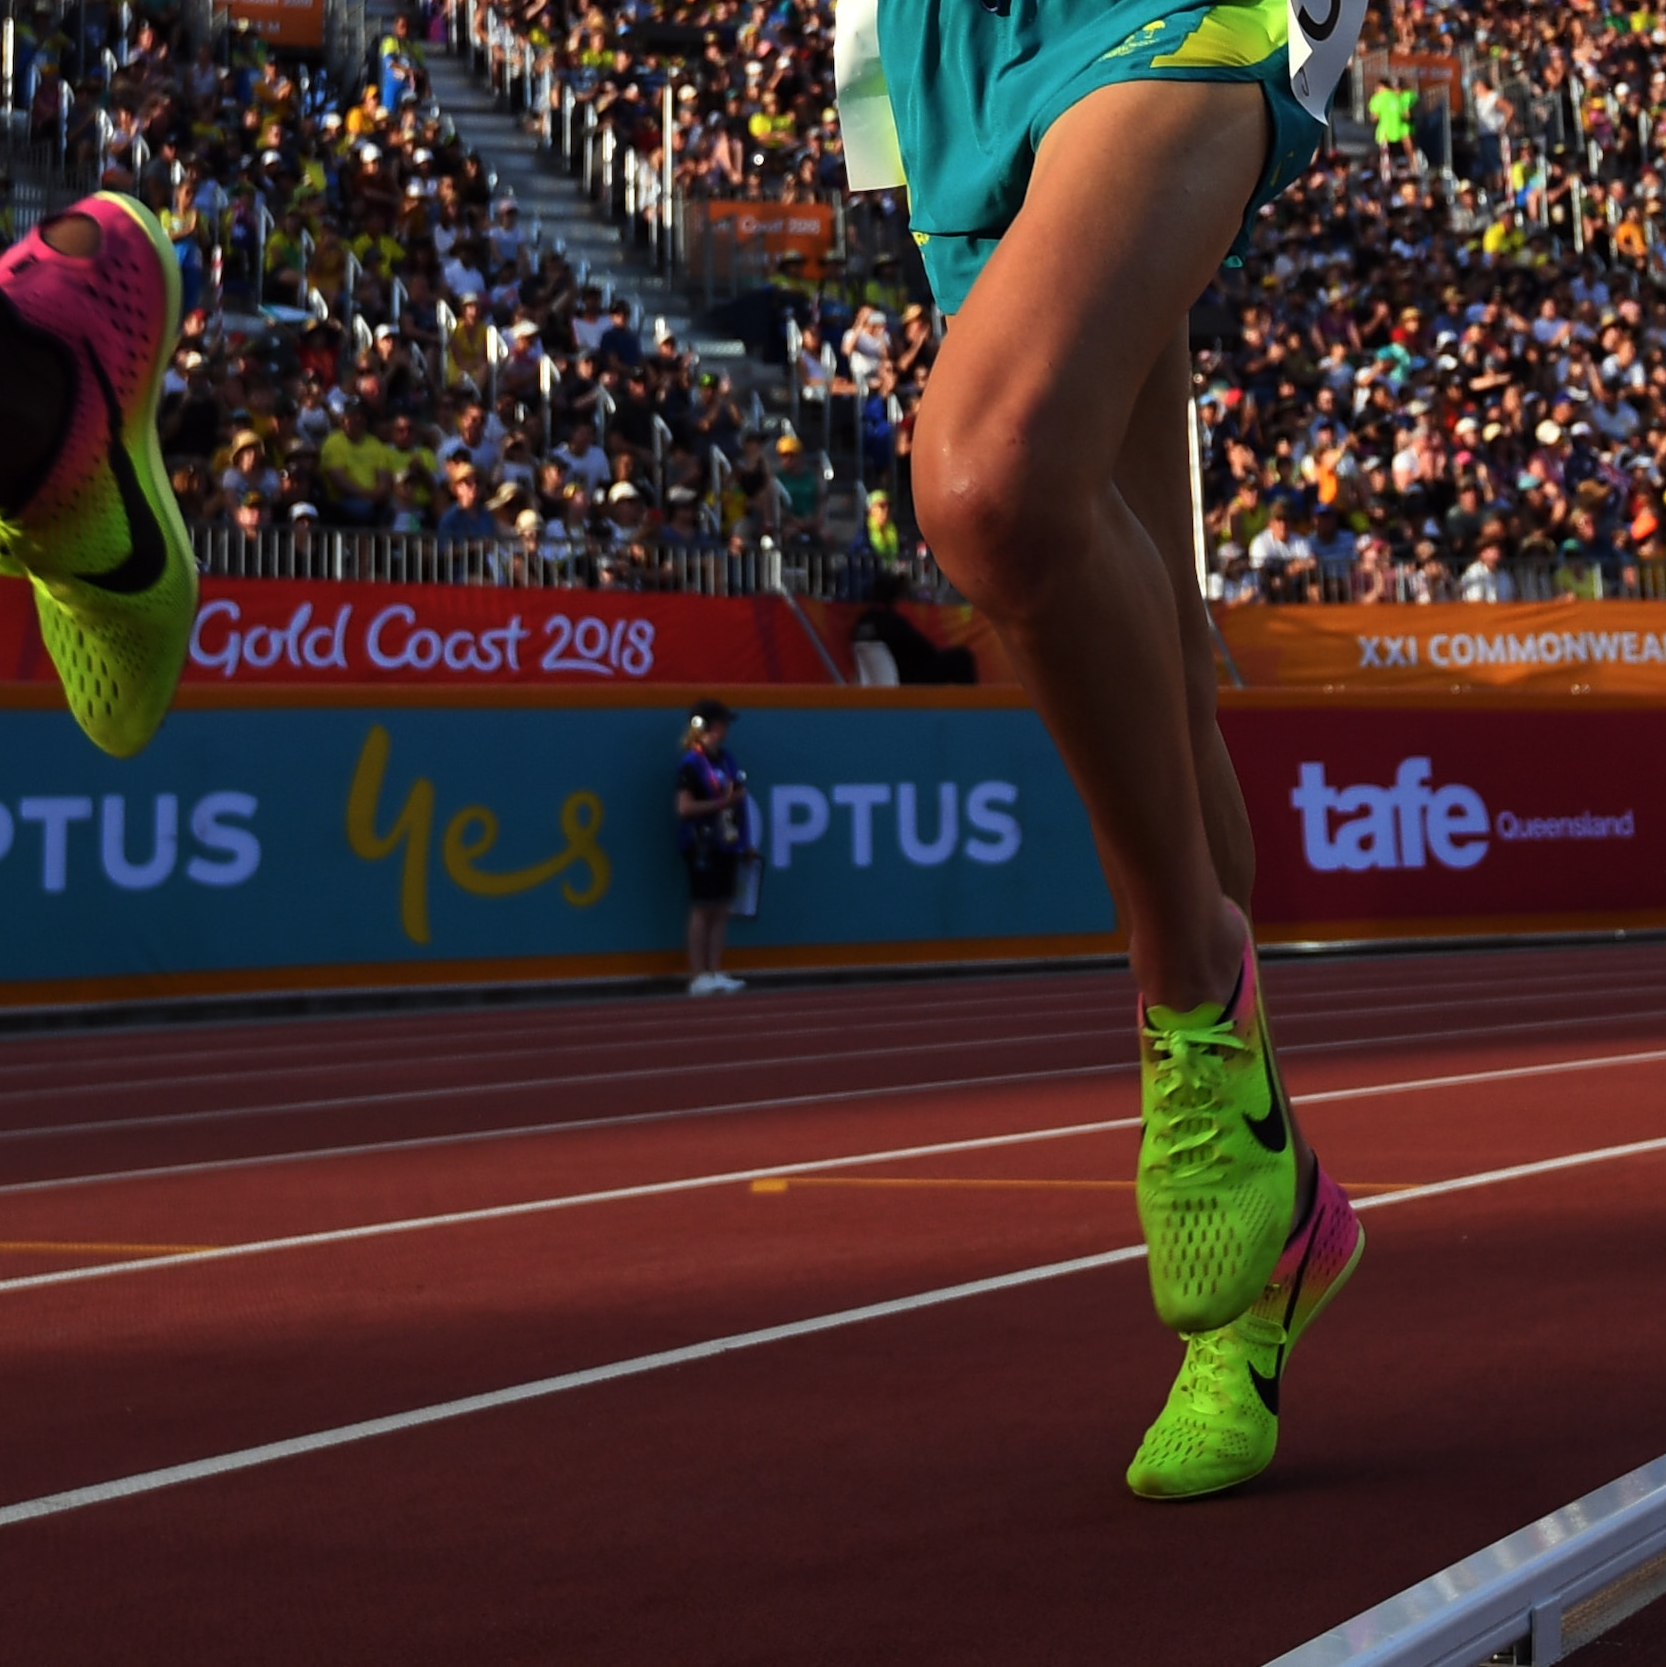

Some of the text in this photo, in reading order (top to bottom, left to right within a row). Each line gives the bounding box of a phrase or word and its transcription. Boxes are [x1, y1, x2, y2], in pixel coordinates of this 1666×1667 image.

[189, 599, 655, 677] Gold Coast 2018
[1357, 633, 1417, 667] XXI
[745, 780, 1021, 869] PTUS
[1290, 756, 1634, 873] tafe Queensland
